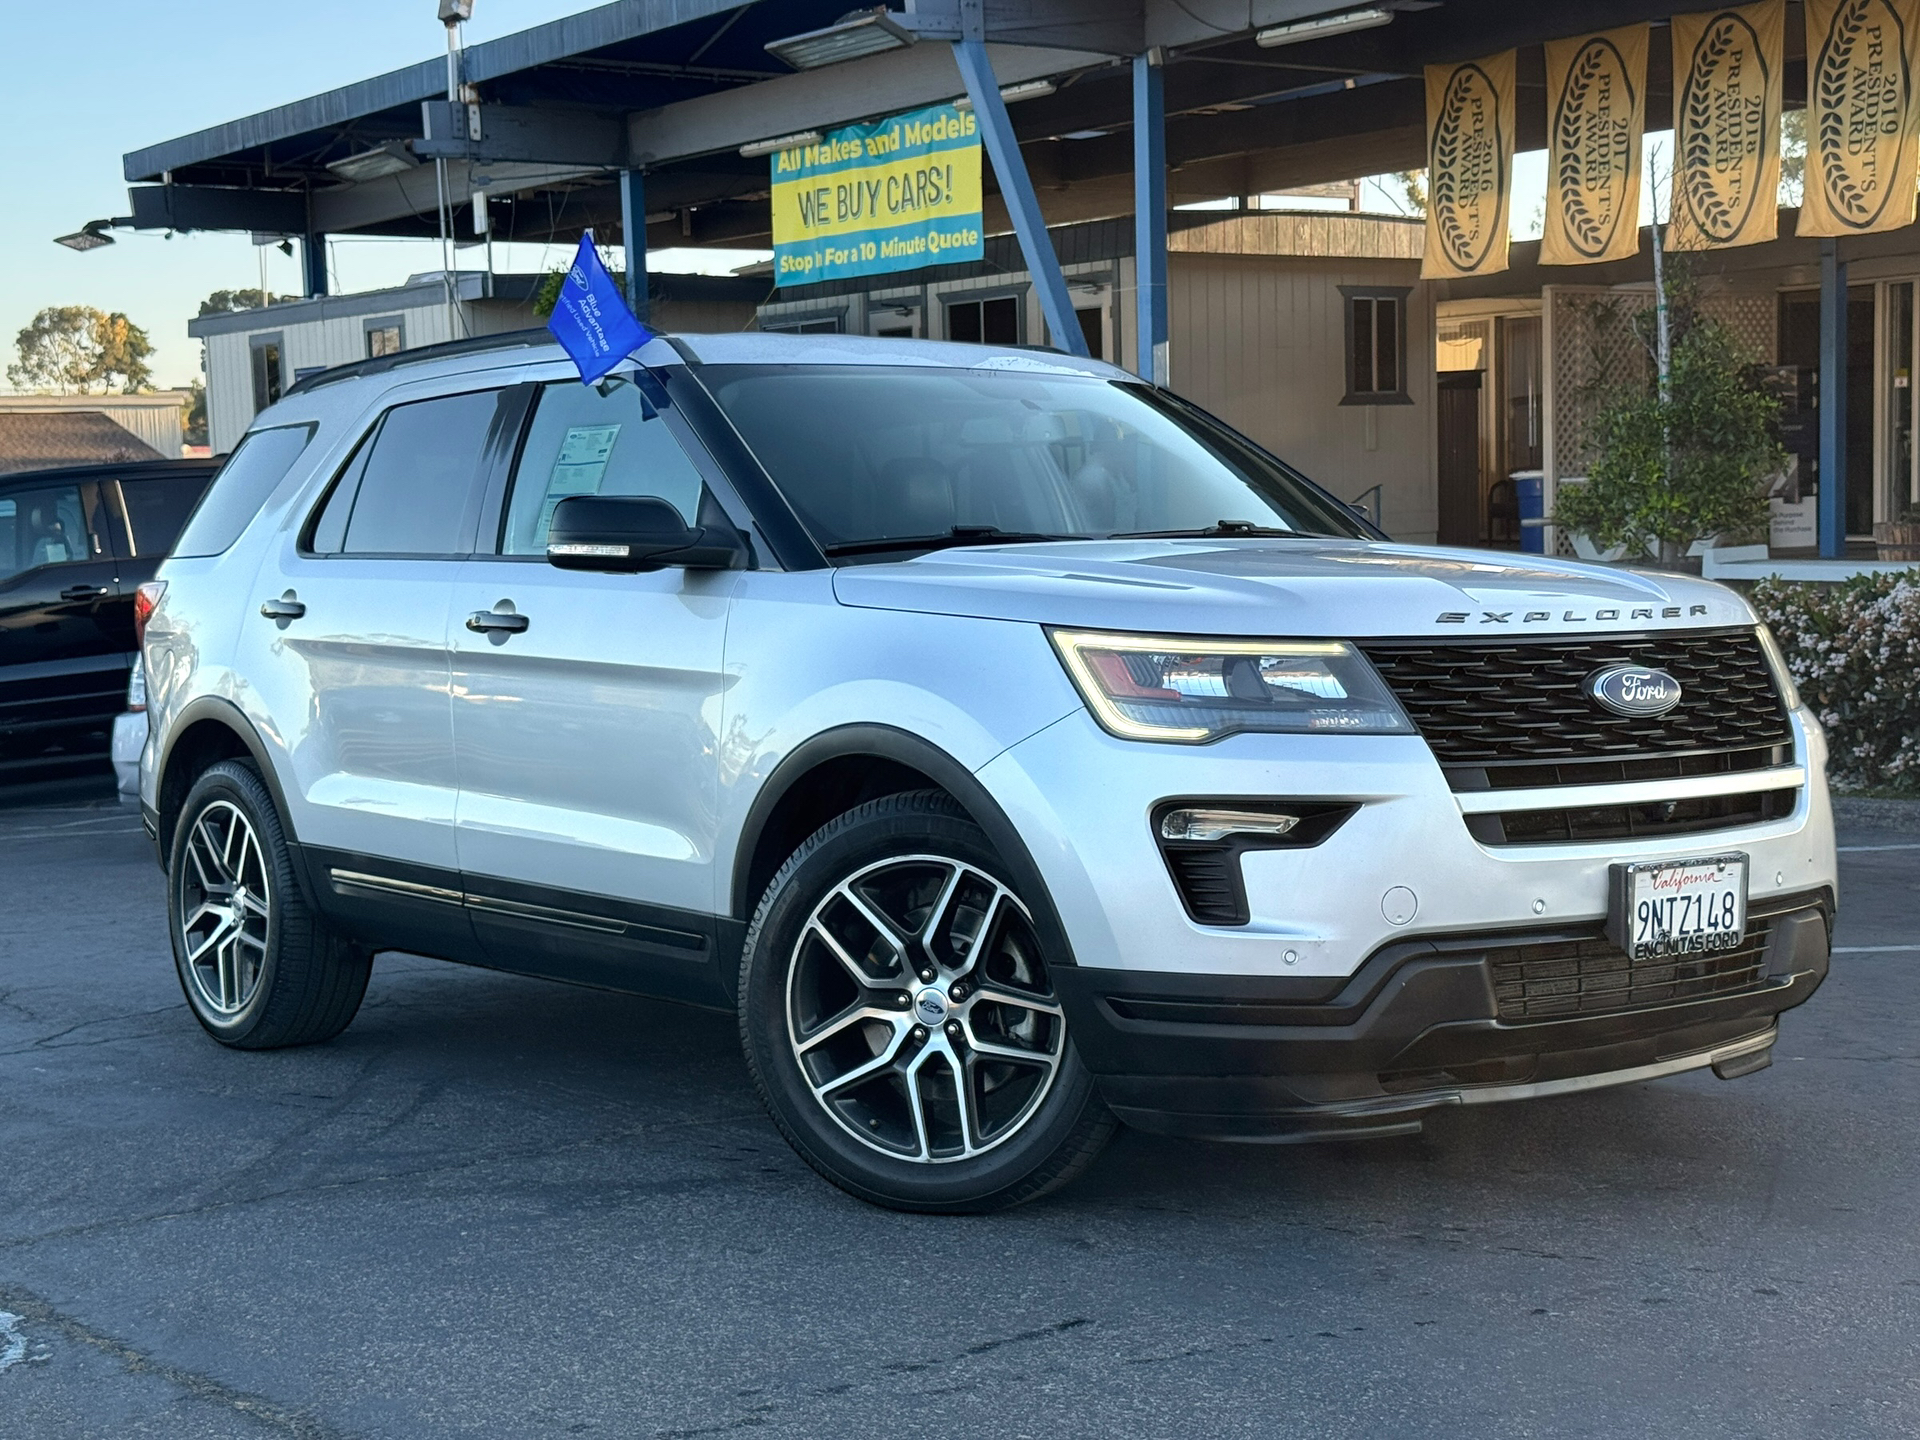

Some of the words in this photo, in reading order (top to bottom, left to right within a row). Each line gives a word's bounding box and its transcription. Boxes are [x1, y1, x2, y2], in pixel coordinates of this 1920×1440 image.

[1713, 87, 1729, 174] AWARD
[1726, 49, 1742, 209] PRESIDENT'S
[1744, 95, 1761, 154] 2018
[1848, 66, 1867, 157] AWARD
[1861, 25, 1883, 192] PRESIDENT'S
[1880, 73, 1898, 135] 2019
[777, 148, 801, 173] All
[805, 138, 862, 167] Makes
[865, 125, 900, 156] and
[904, 111, 976, 147] Models
[1458, 131, 1473, 209] AWARD
[1468, 95, 1485, 241] PRESIDENT'S
[1480, 138, 1493, 192] 2016
[1585, 110, 1598, 192] AWARD
[1598, 74, 1611, 226] PRESIDENT'S
[798, 187, 831, 228] WE
[837, 178, 882, 222] BUY
[886, 164, 953, 214] CARS!
[780, 254, 813, 274] Stop
[824, 247, 849, 266] For
[851, 248, 858, 262] a
[859, 242, 876, 260] 10
[880, 236, 926, 259] Minute
[927, 229, 979, 254] Quote
[578, 299, 610, 352] Advantage
[586, 293, 601, 317] Blue
[573, 313, 588, 332] Used
[586, 330, 600, 358] Vehicle
[1435, 604, 1708, 623] EXPLORER
[1620, 673, 1668, 702] Ford
[1652, 867, 1722, 894] California
[1637, 891, 1735, 941] 9NTZ148
[1706, 931, 1739, 950] FORD
